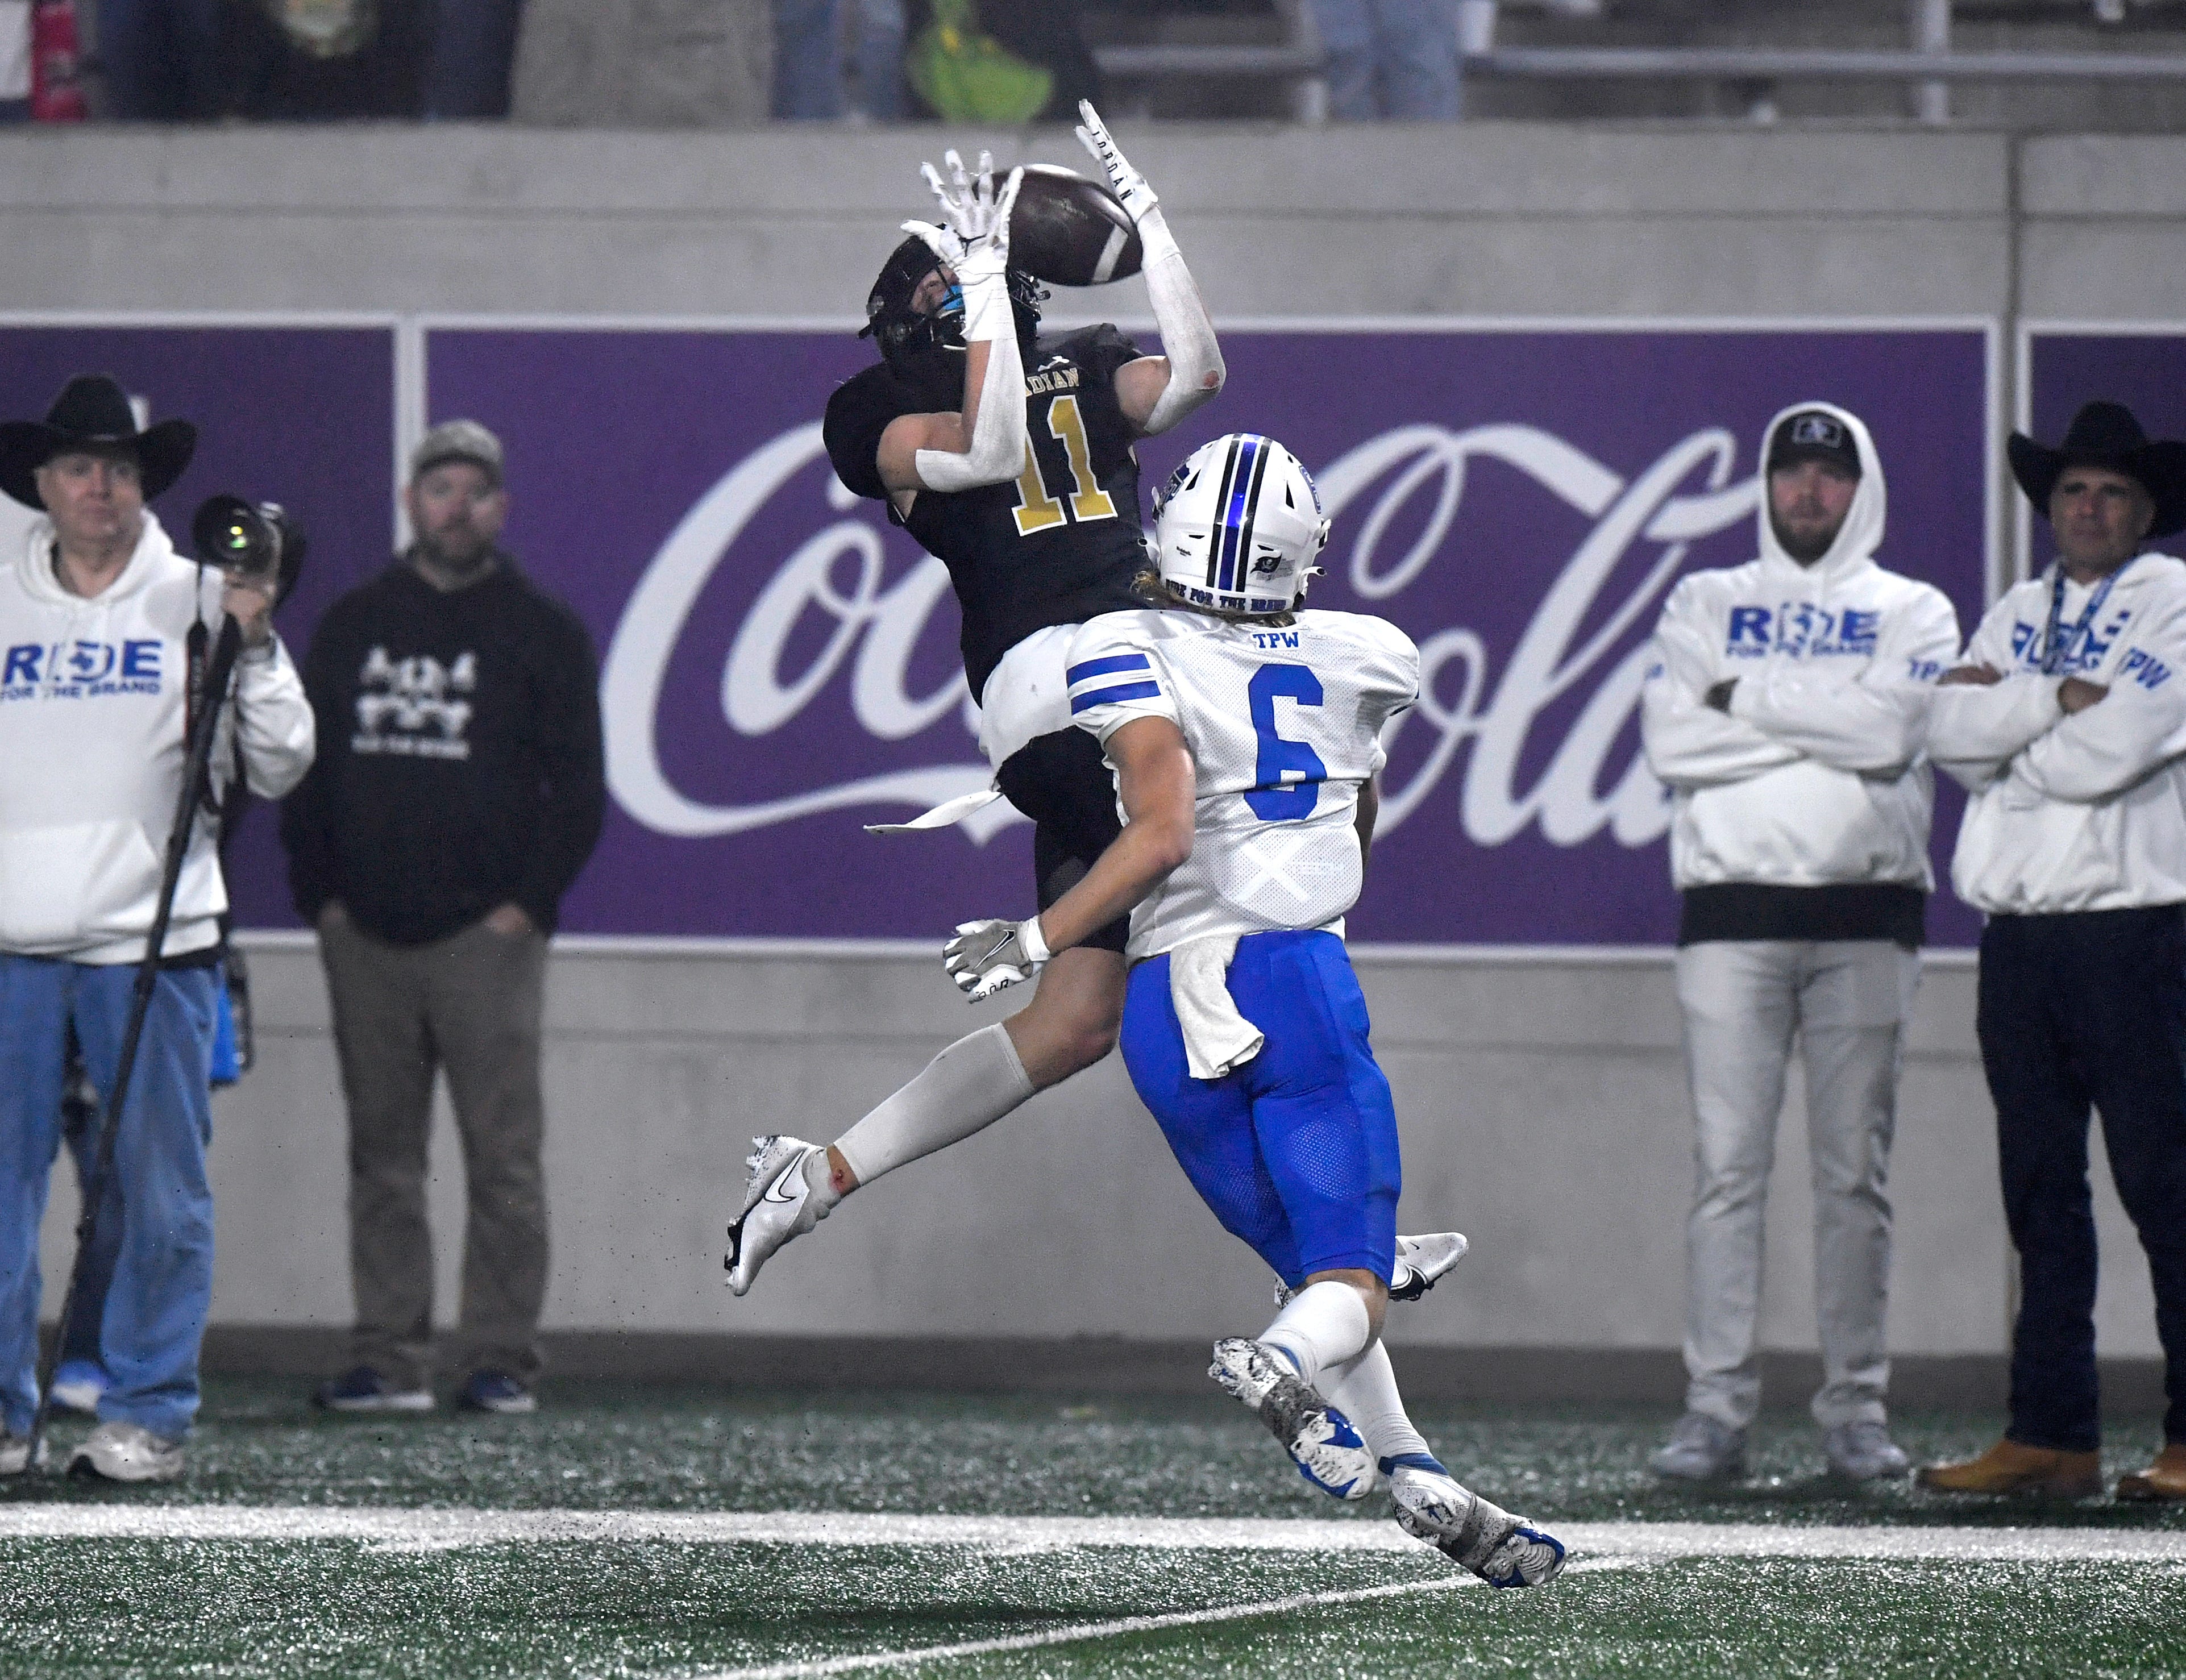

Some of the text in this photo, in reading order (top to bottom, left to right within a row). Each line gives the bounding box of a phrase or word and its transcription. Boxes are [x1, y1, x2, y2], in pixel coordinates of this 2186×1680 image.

[1091, 131, 1133, 201] JORDAN
[1011, 394, 1118, 537] 11
[1190, 588, 1213, 606] FOR
[1219, 595, 1246, 610] THE
[1253, 631, 1299, 649] TPW
[1907, 657, 1942, 681] TP
[1244, 663, 1328, 821] 6
